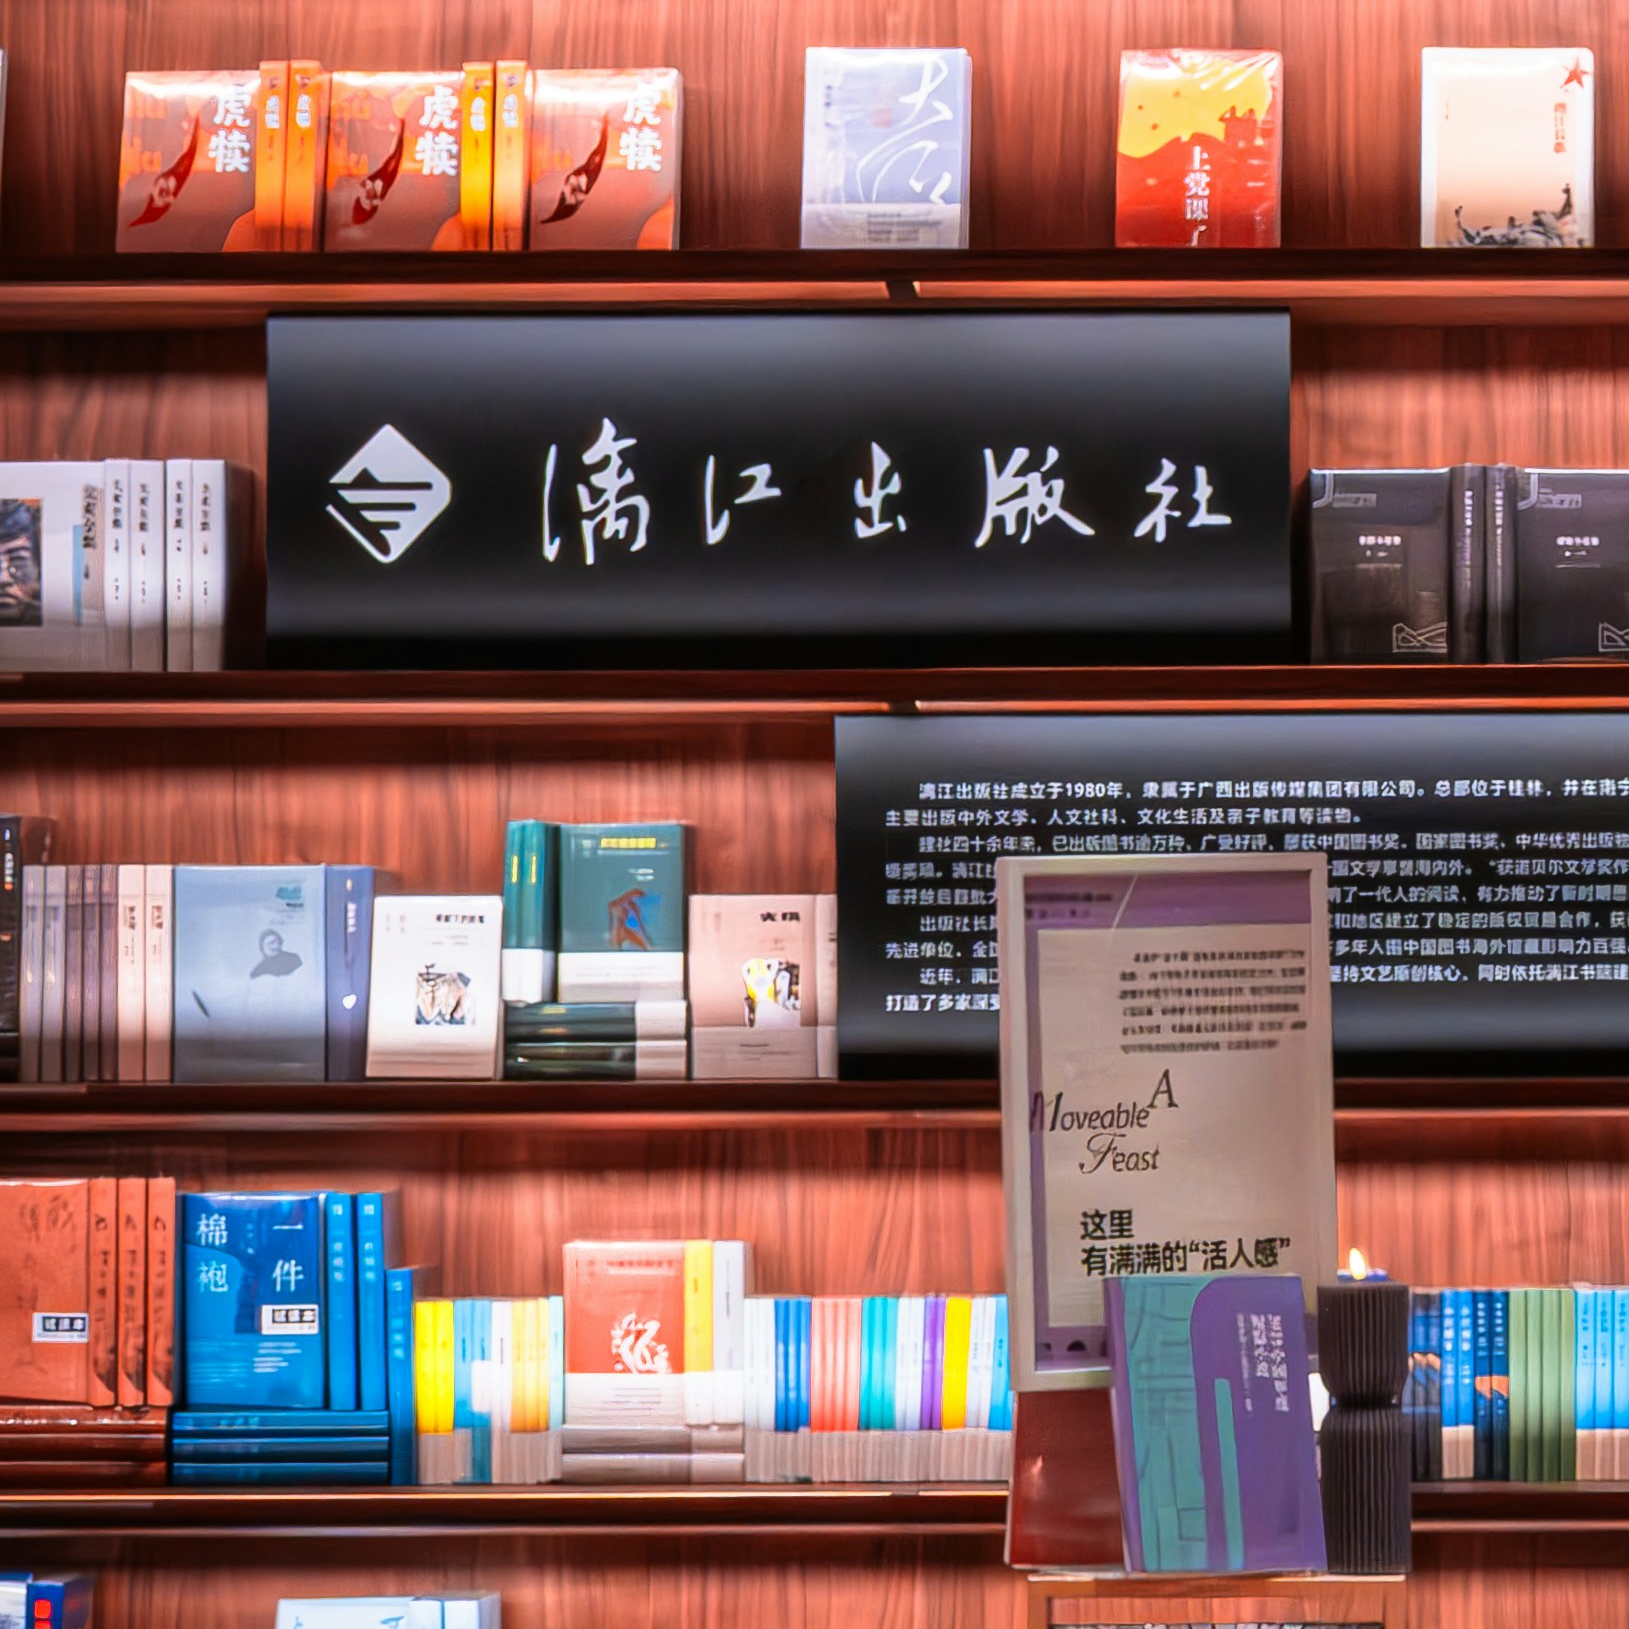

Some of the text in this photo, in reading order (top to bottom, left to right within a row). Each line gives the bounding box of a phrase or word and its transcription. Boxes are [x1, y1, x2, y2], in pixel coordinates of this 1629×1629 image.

[415, 84, 460, 178] 虎犊
[543, 418, 1231, 565] 漓江出版社
[1147, 1068, 1179, 1109] A
[1079, 1133, 1160, 1174] Feast
[195, 1213, 229, 1294] 棉袍
[272, 1221, 304, 1293] 一件
[1080, 1208, 1134, 1241] 这里
